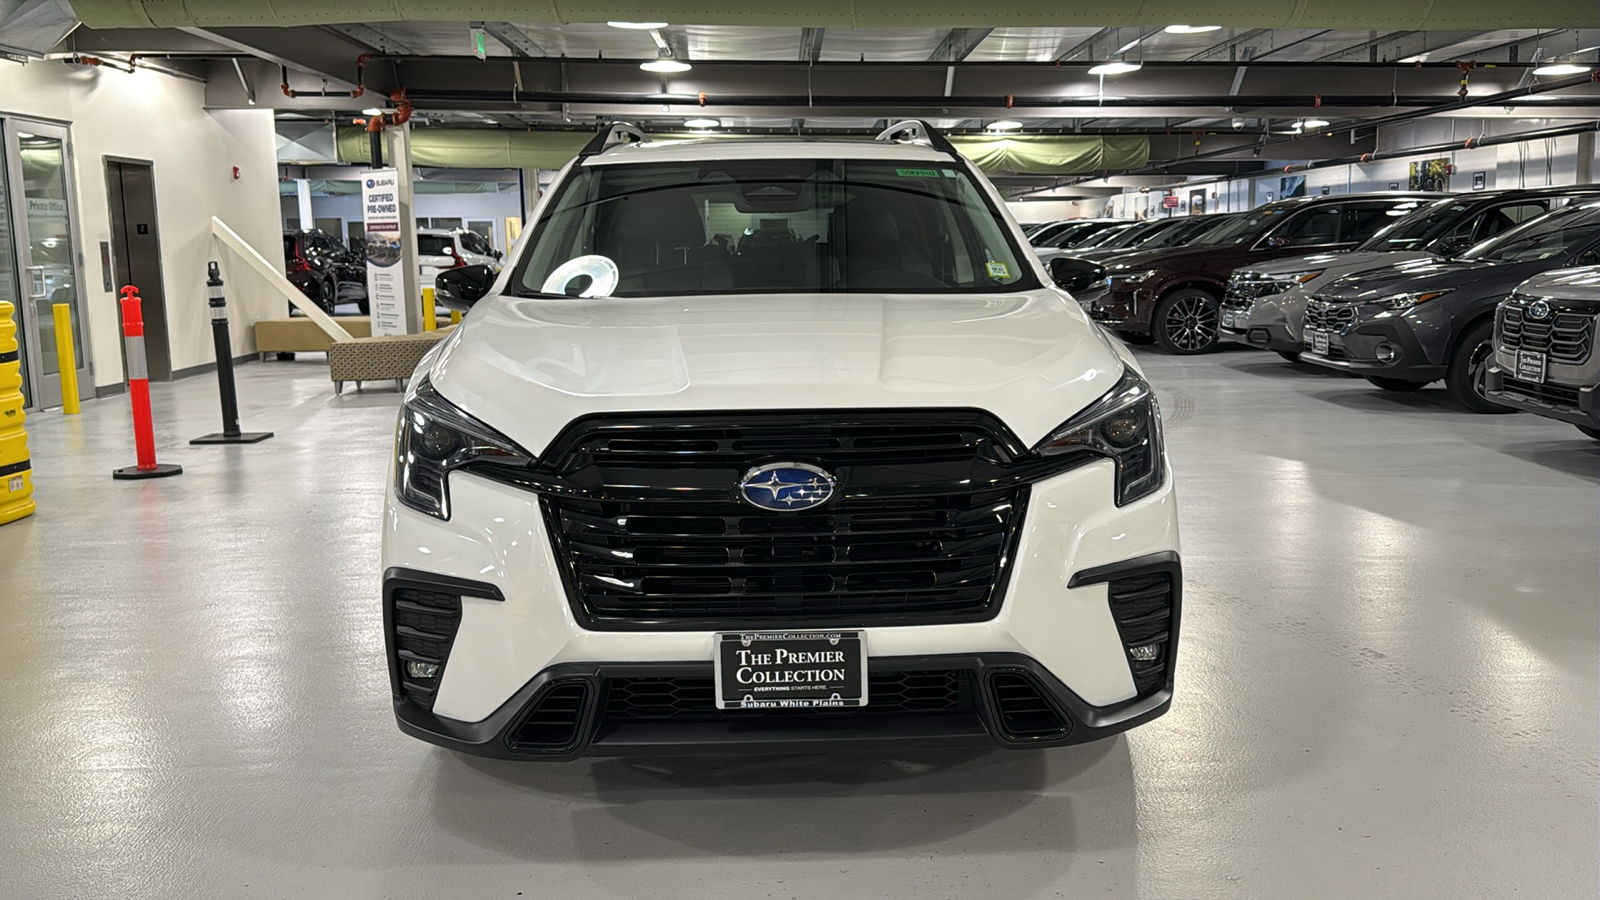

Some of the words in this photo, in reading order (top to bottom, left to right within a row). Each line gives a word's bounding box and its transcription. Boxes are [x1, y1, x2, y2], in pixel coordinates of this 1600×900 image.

[368, 193, 394, 203] CERTIFIED
[29, 200, 48, 210] Private
[367, 204, 397, 213] PRE-OWNED
[736, 650, 772, 666] THE
[775, 648, 845, 665] PREMIER
[736, 666, 845, 684] COLLECTION
[740, 700, 777, 708] Subaru
[813, 699, 844, 707] Plains
